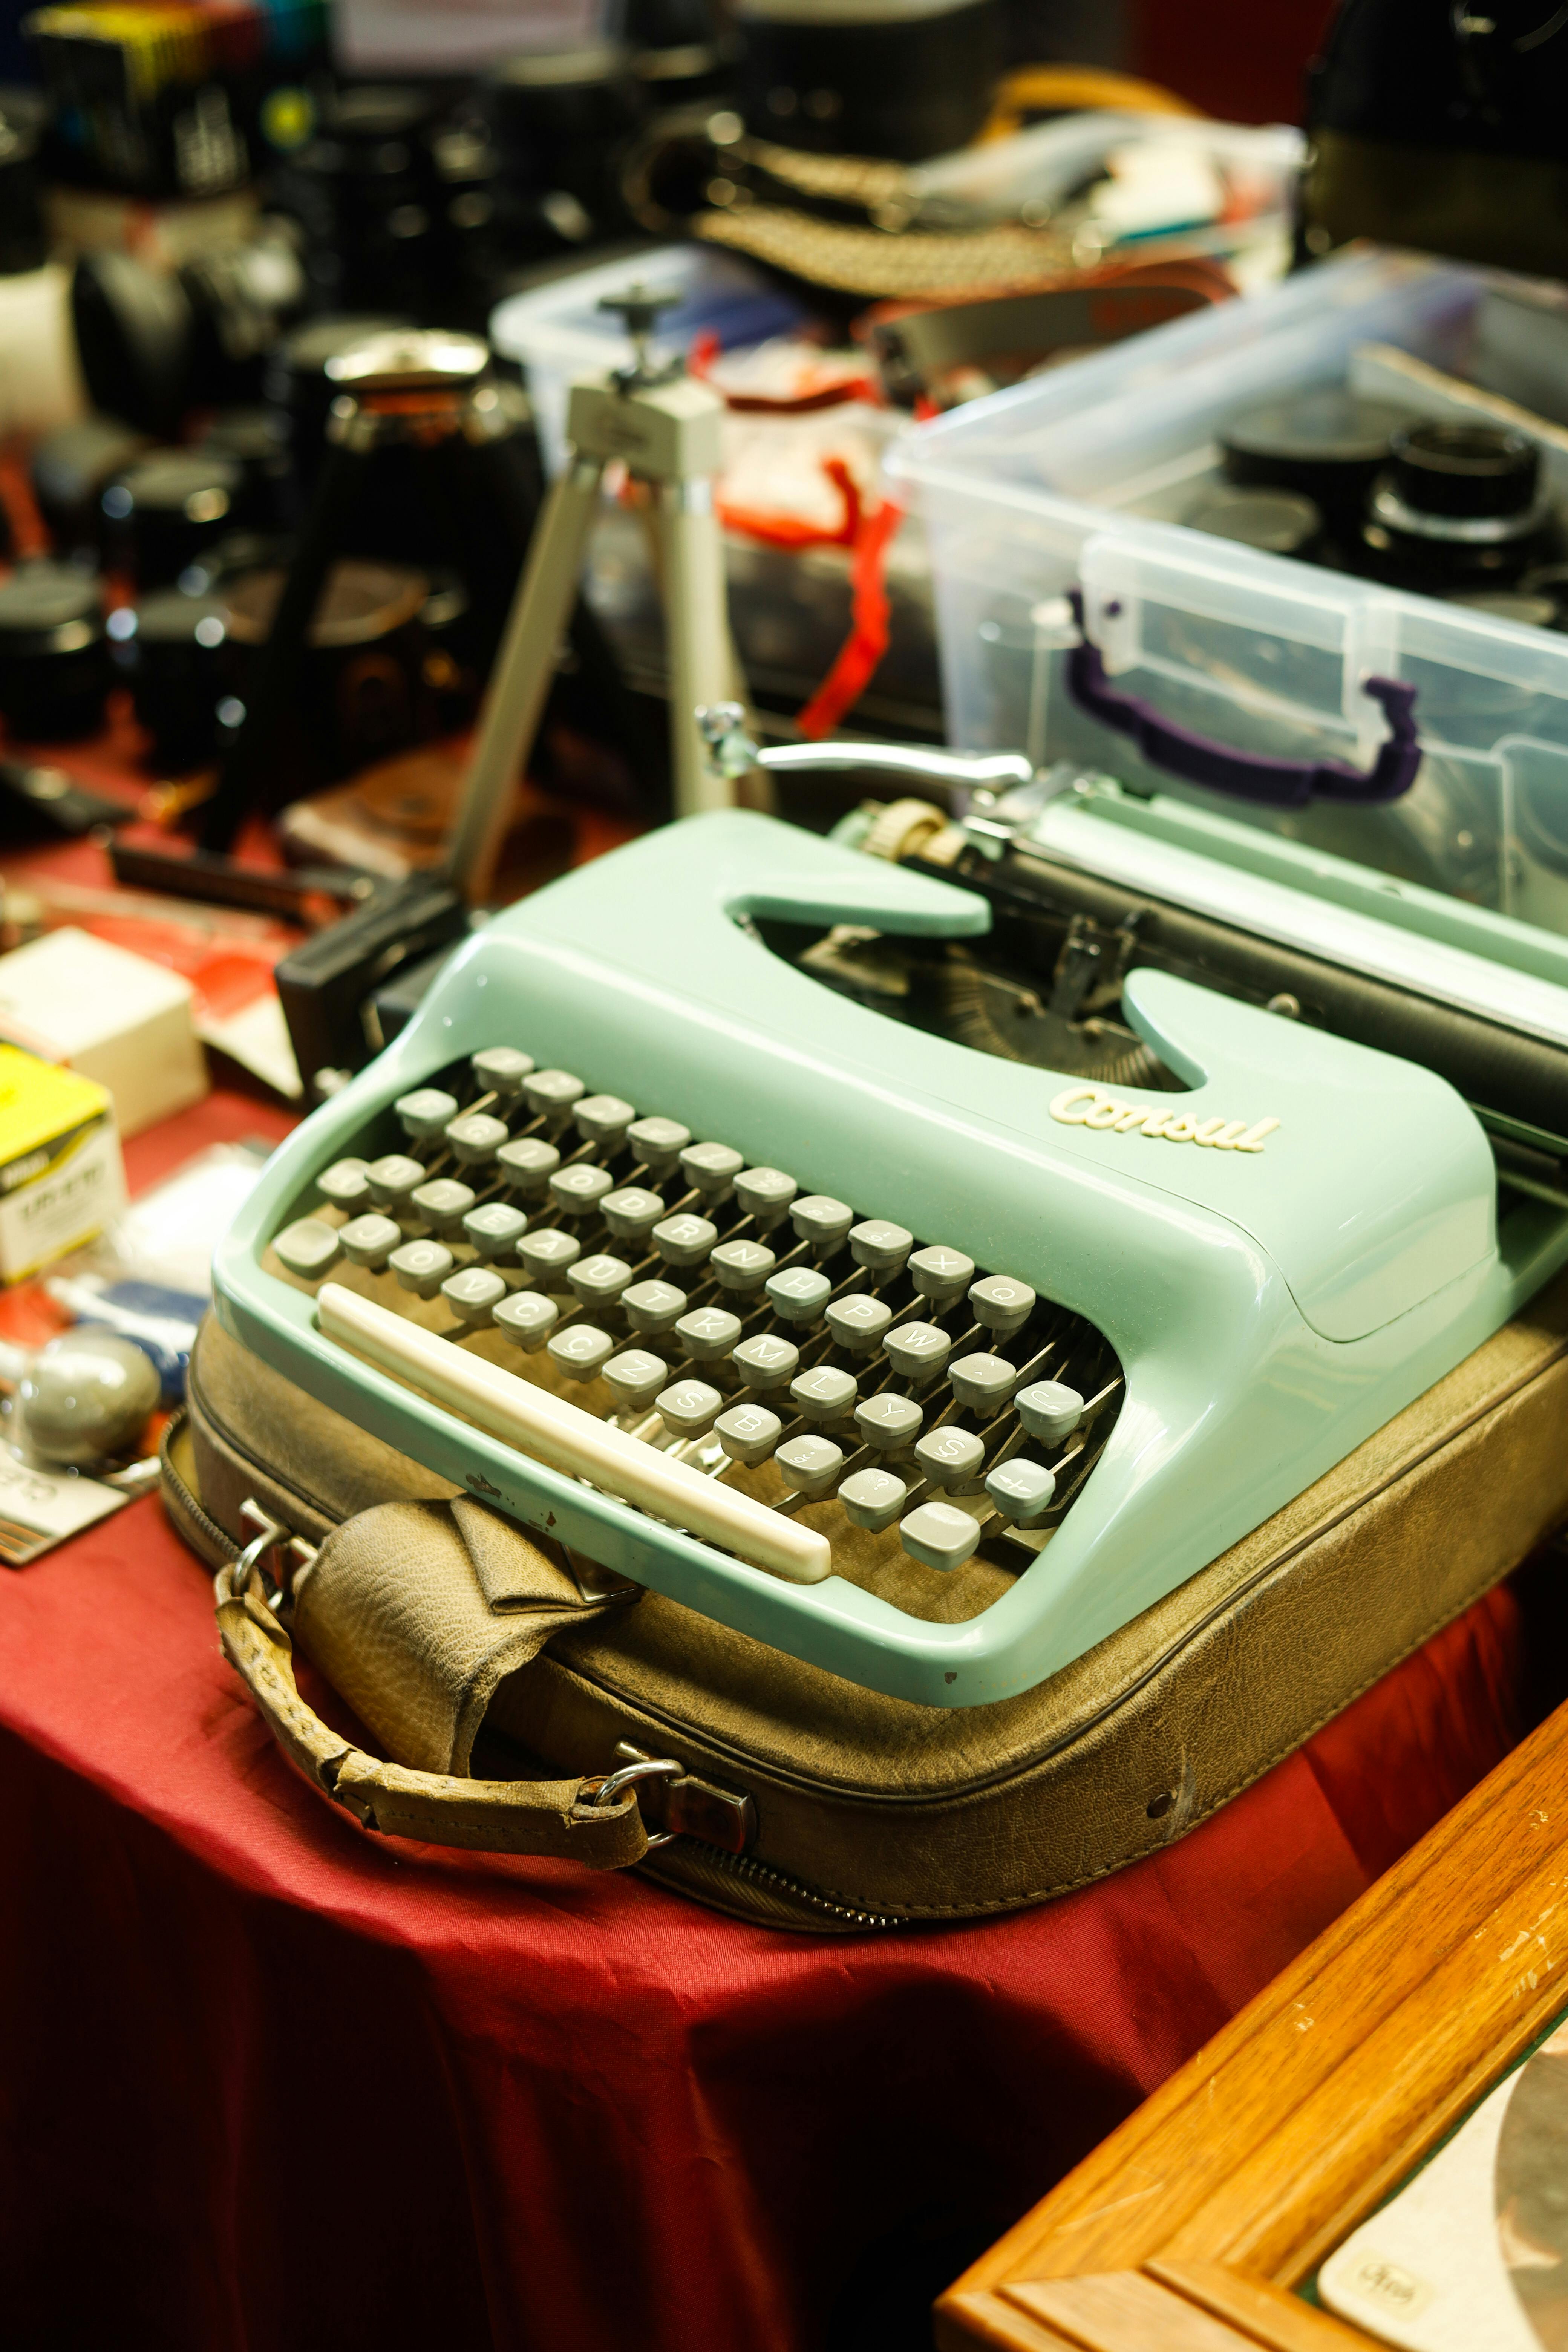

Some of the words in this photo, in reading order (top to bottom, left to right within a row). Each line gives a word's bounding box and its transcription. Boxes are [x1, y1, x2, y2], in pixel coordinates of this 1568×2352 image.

[1049, 1086, 1280, 1153] Consul
[482, 1213, 512, 1228] E
[534, 1239, 559, 1253] A
[645, 1289, 671, 1303] T
[694, 1316, 725, 1333] K
[749, 1342, 785, 1362] M
[810, 1375, 828, 1393] L
[881, 1403, 906, 1418] Y
[618, 1195, 646, 1208] D
[671, 1222, 700, 1239] R
[729, 1247, 760, 1263] N
[784, 1276, 815, 1292] H
[844, 1304, 873, 1317] P
[904, 1329, 937, 1348] W
[928, 1254, 958, 1269] X
[991, 1287, 1015, 1300] Q
[463, 1278, 488, 1294] V
[514, 1302, 540, 1318] C
[563, 1337, 593, 1354] Ç
[620, 1359, 651, 1377] Z
[677, 1392, 704, 1408] S
[733, 1413, 762, 1432] B
[873, 1478, 890, 1491] ?
